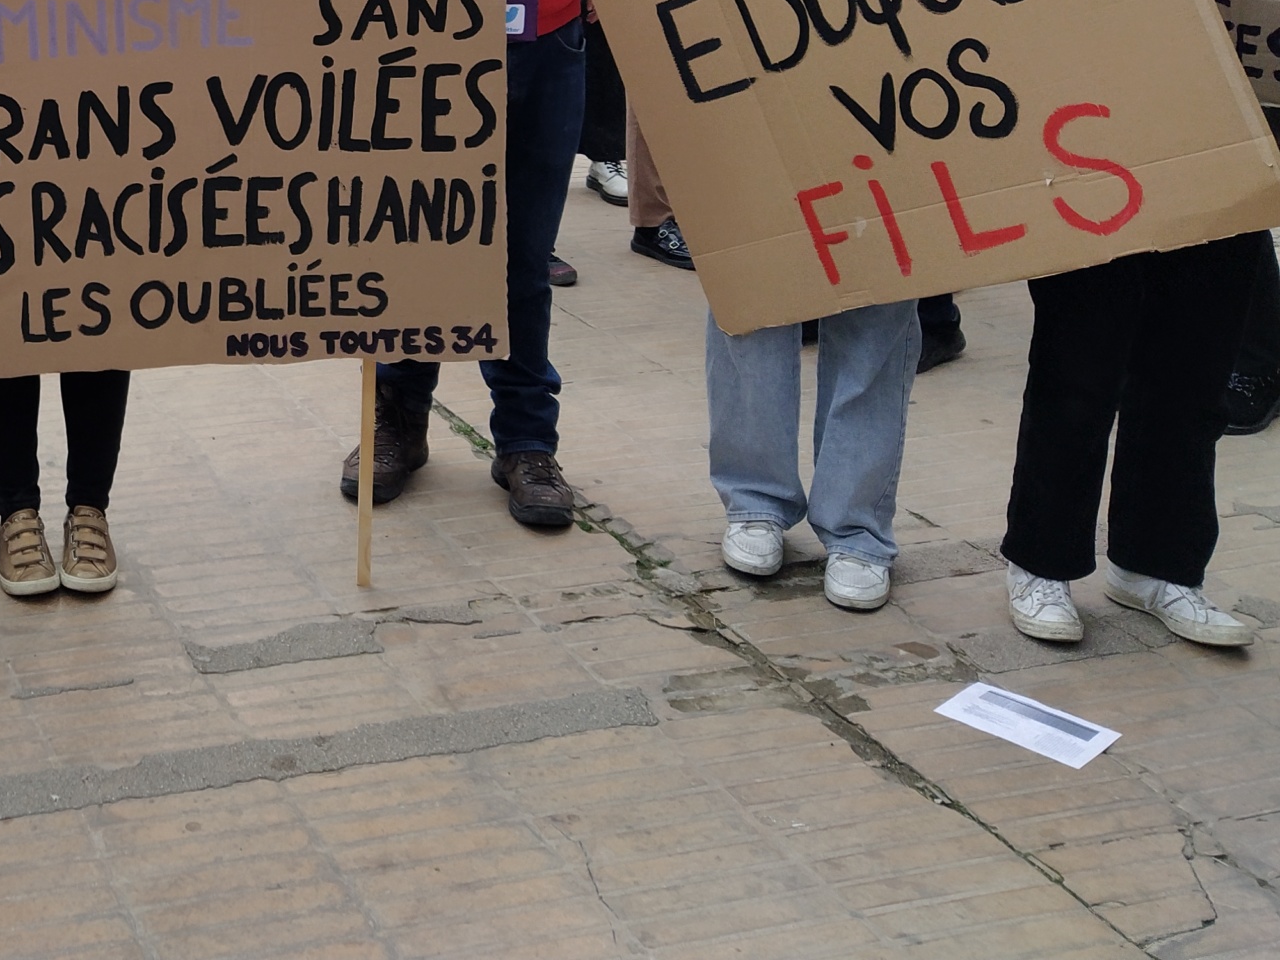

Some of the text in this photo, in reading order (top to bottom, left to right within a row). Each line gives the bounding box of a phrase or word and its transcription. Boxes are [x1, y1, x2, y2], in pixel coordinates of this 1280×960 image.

[829, 38, 1020, 155] VOS
[21, 281, 112, 344] LES
[226, 323, 498, 358] NOUS TOUTES 34
